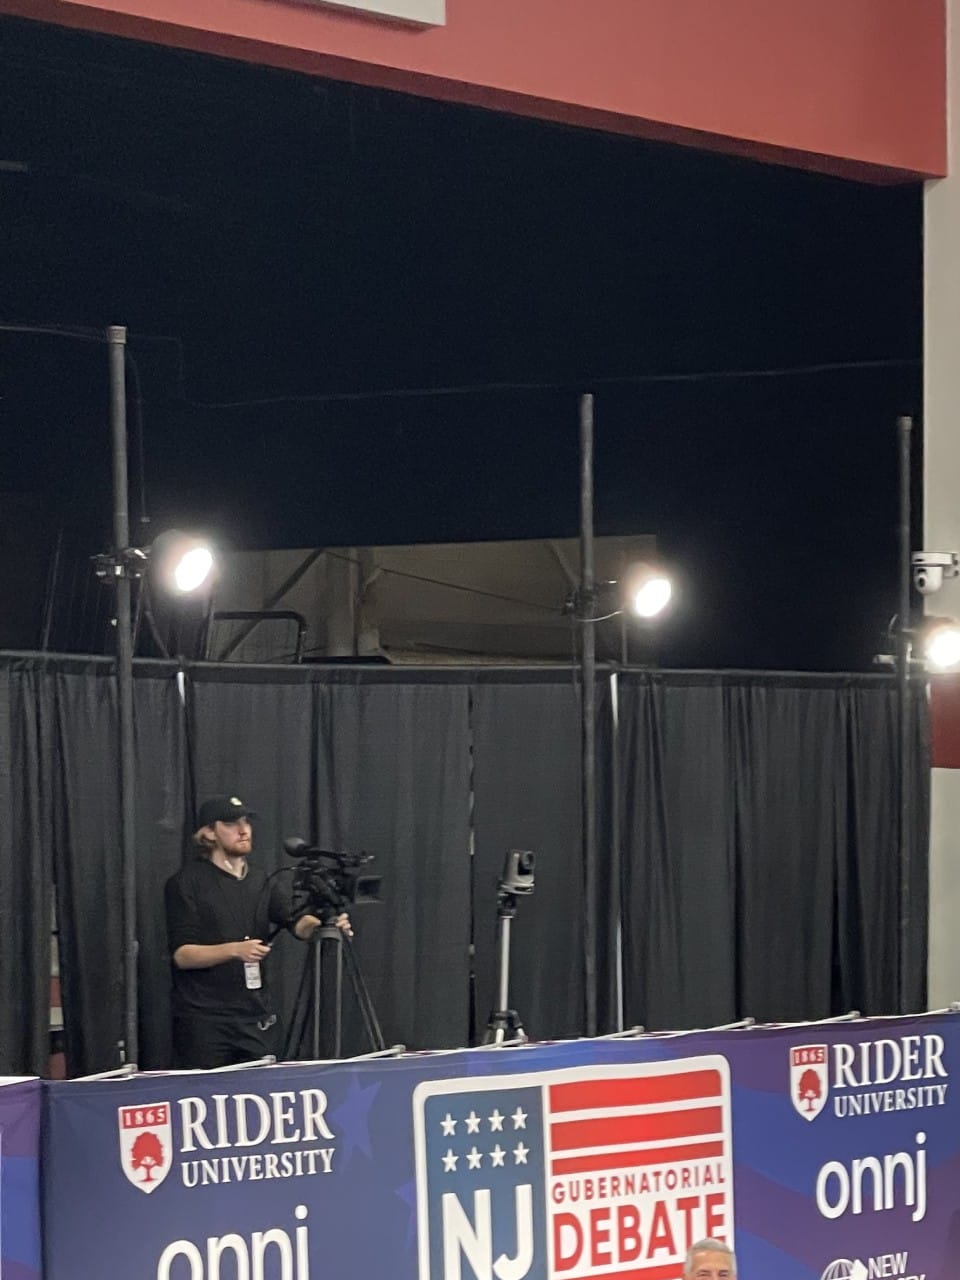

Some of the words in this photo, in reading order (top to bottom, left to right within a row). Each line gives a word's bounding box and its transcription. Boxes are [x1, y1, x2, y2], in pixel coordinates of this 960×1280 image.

[794, 1048, 825, 1065] 1865
[833, 1034, 949, 1089] RIDER
[124, 1107, 166, 1127] 1865
[177, 1088, 336, 1153] RIDER
[834, 1084, 949, 1118] UNIVERSITY
[181, 1148, 336, 1188] UNIVERSITY
[552, 1163, 726, 1205] GUBERNATORIAL
[816, 1132, 928, 1223] onnj
[553, 1191, 727, 1272] DEBATE
[868, 1251, 909, 1278] NEW
